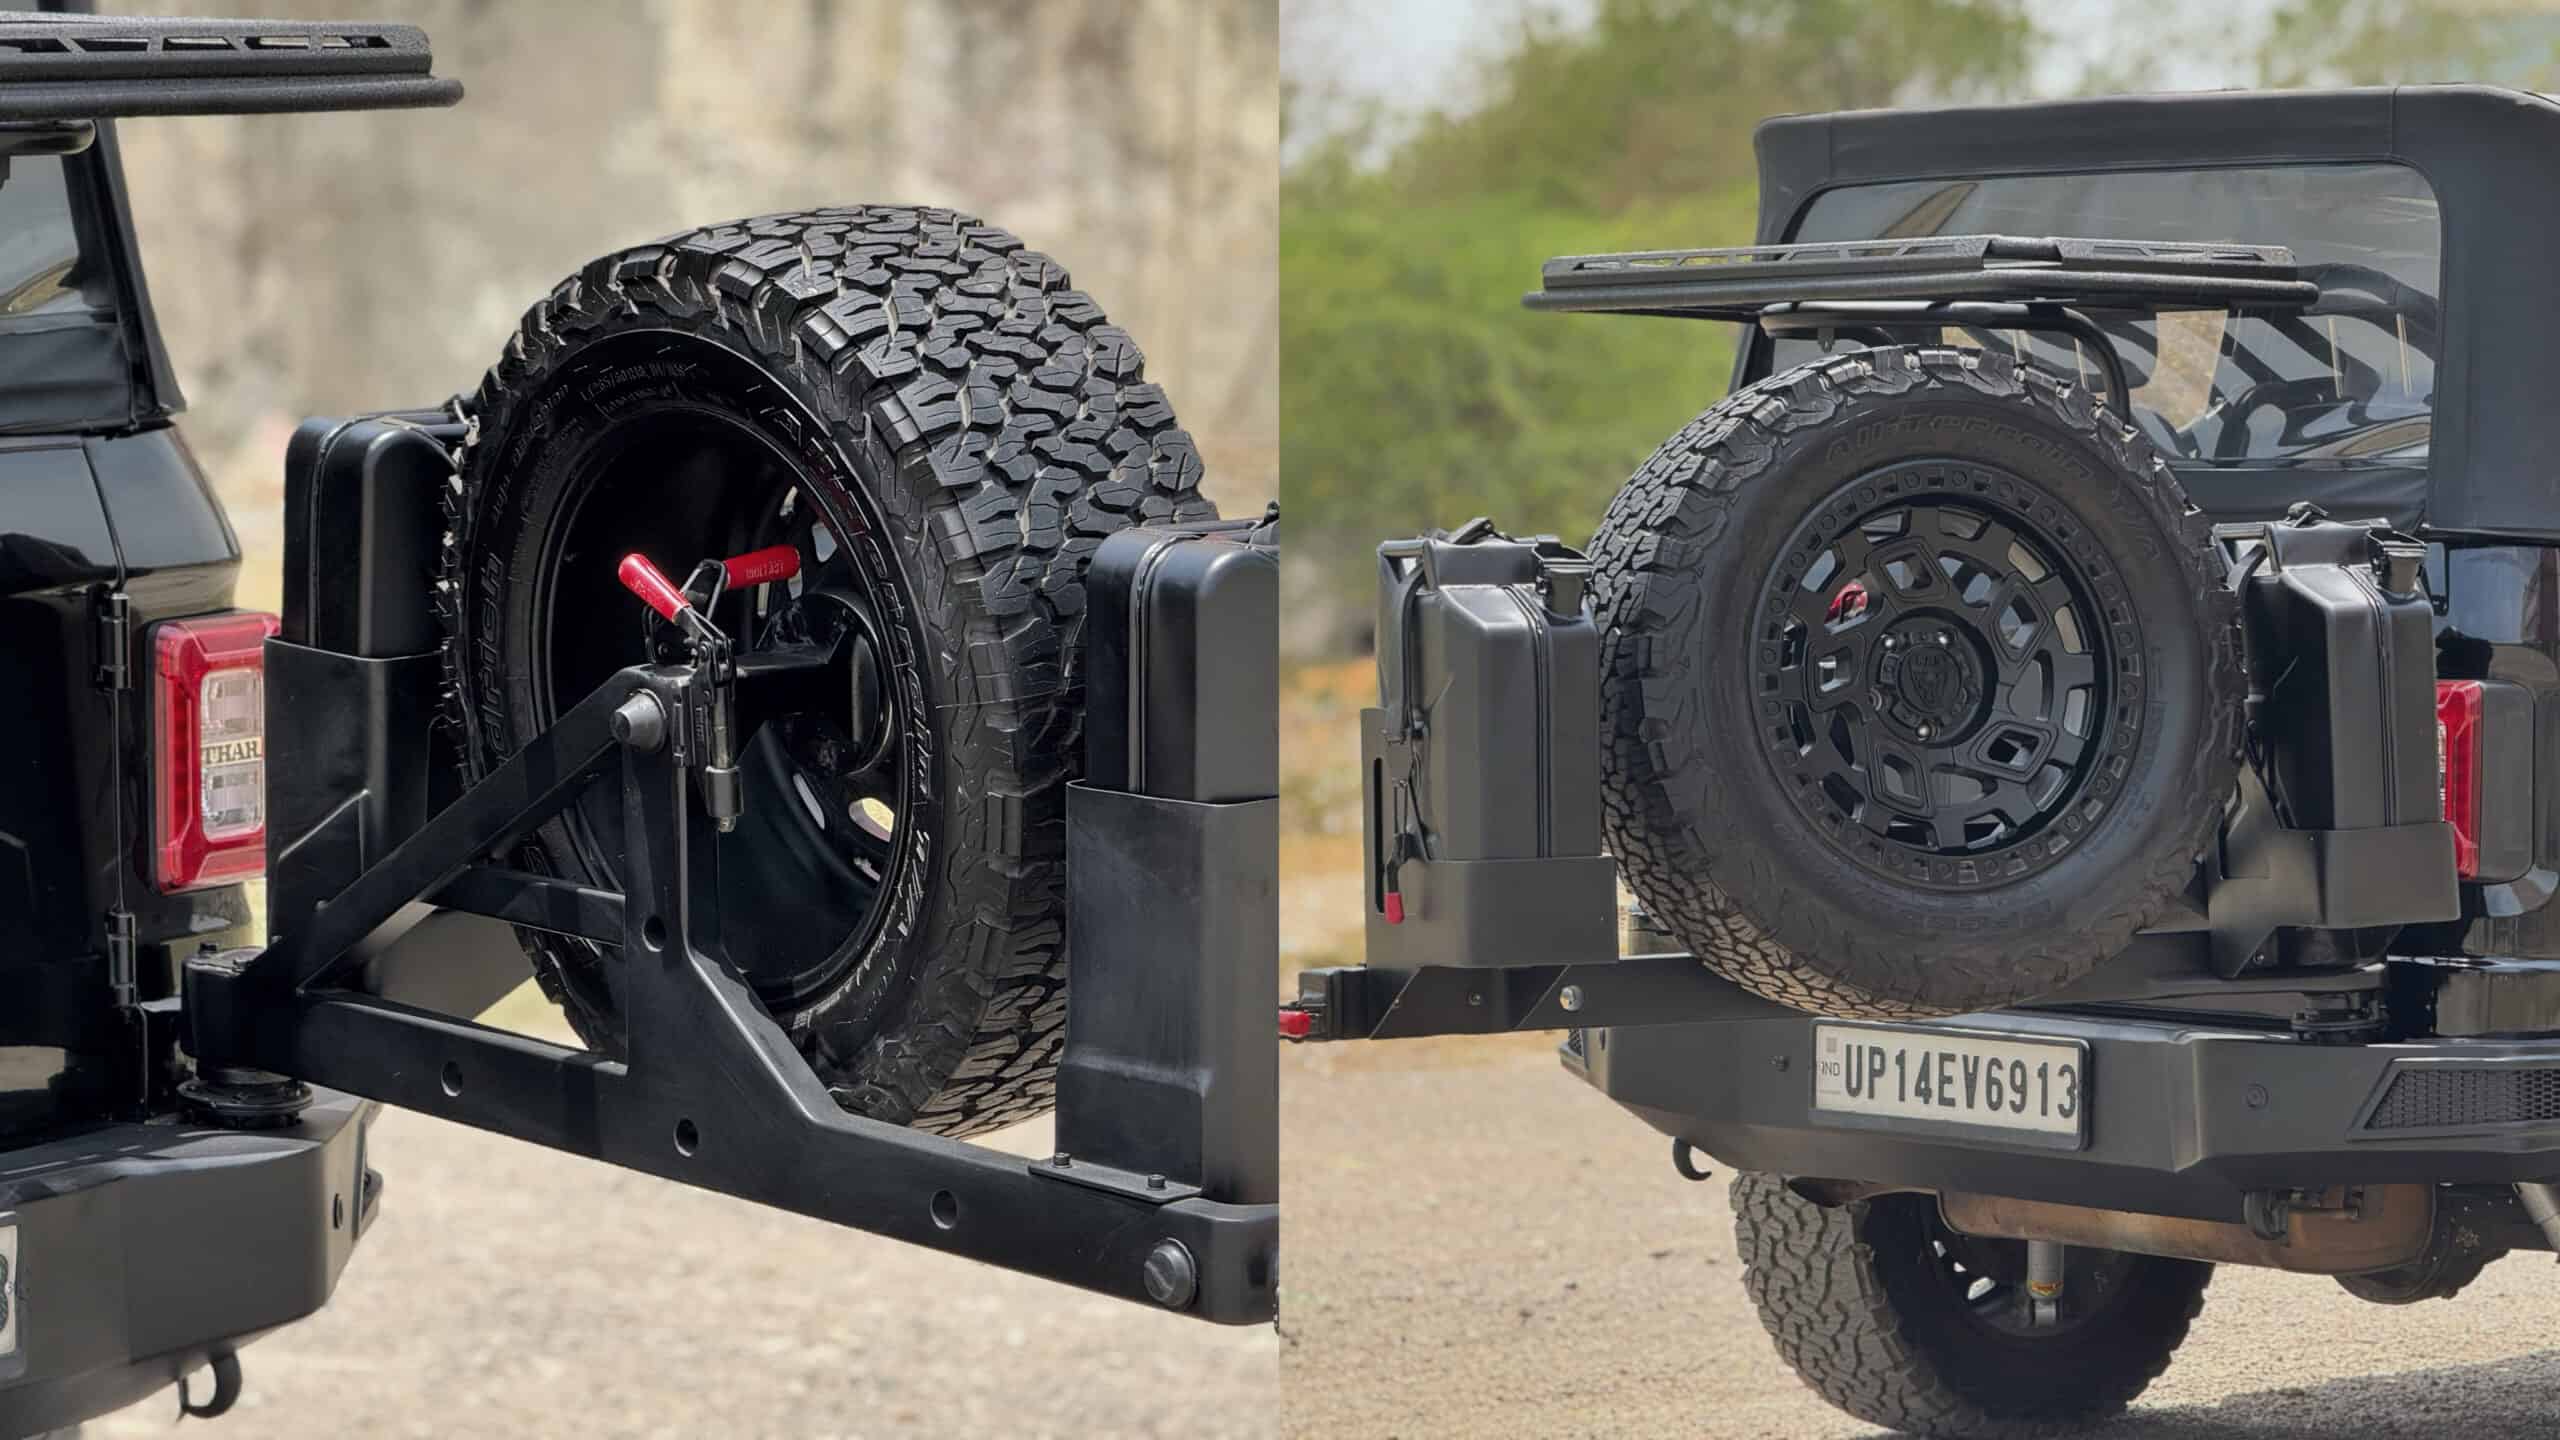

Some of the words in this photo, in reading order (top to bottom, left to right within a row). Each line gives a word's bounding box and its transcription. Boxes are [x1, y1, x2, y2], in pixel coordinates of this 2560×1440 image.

[477, 551, 512, 762] drich
[202, 741, 261, 764] THAR
[1845, 1043, 2078, 1119] UP14EV6913
